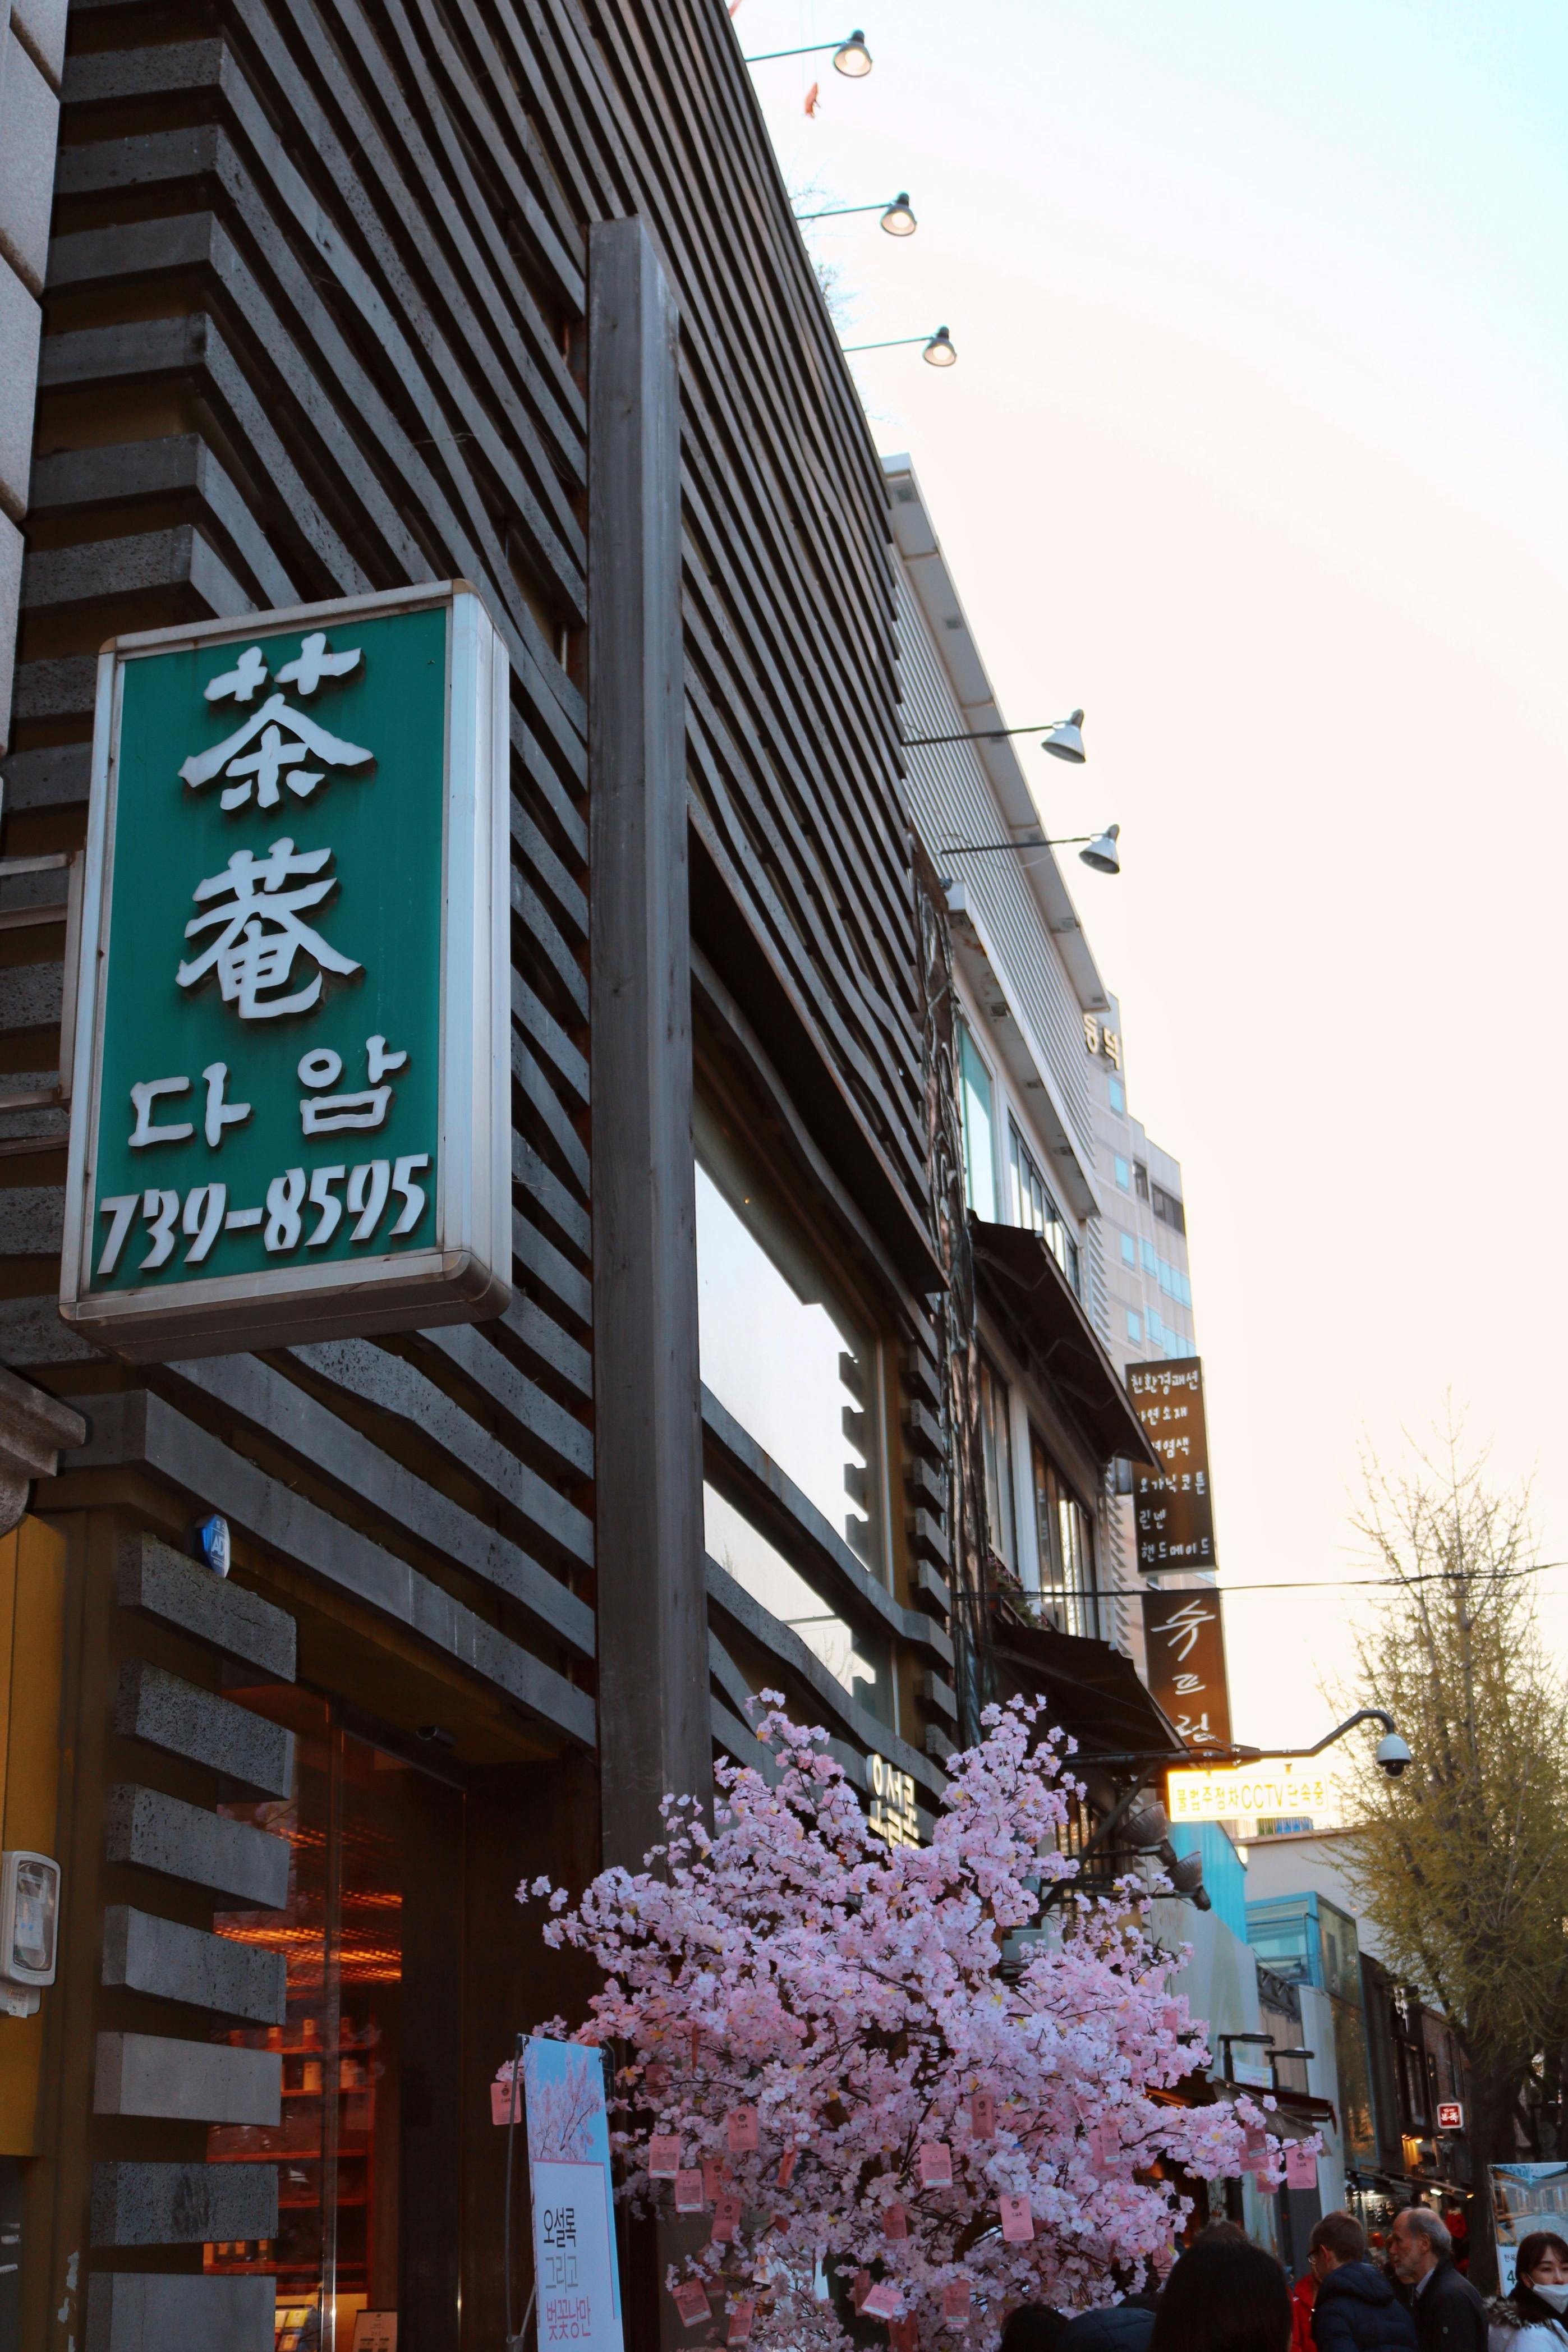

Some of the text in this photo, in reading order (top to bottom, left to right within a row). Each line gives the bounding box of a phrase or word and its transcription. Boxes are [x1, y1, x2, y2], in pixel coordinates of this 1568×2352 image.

[96, 1152, 430, 1275] 739-8595
[1130, 1370, 1198, 1396] 친환경패션
[1139, 1509, 1167, 1531] 린넨
[1141, 1537, 1210, 1563] 핸드메이드
[544, 2207, 576, 2248] 오설록
[545, 2252, 579, 2294] 그리고
[546, 2295, 591, 2342] 벚꽃낭만
